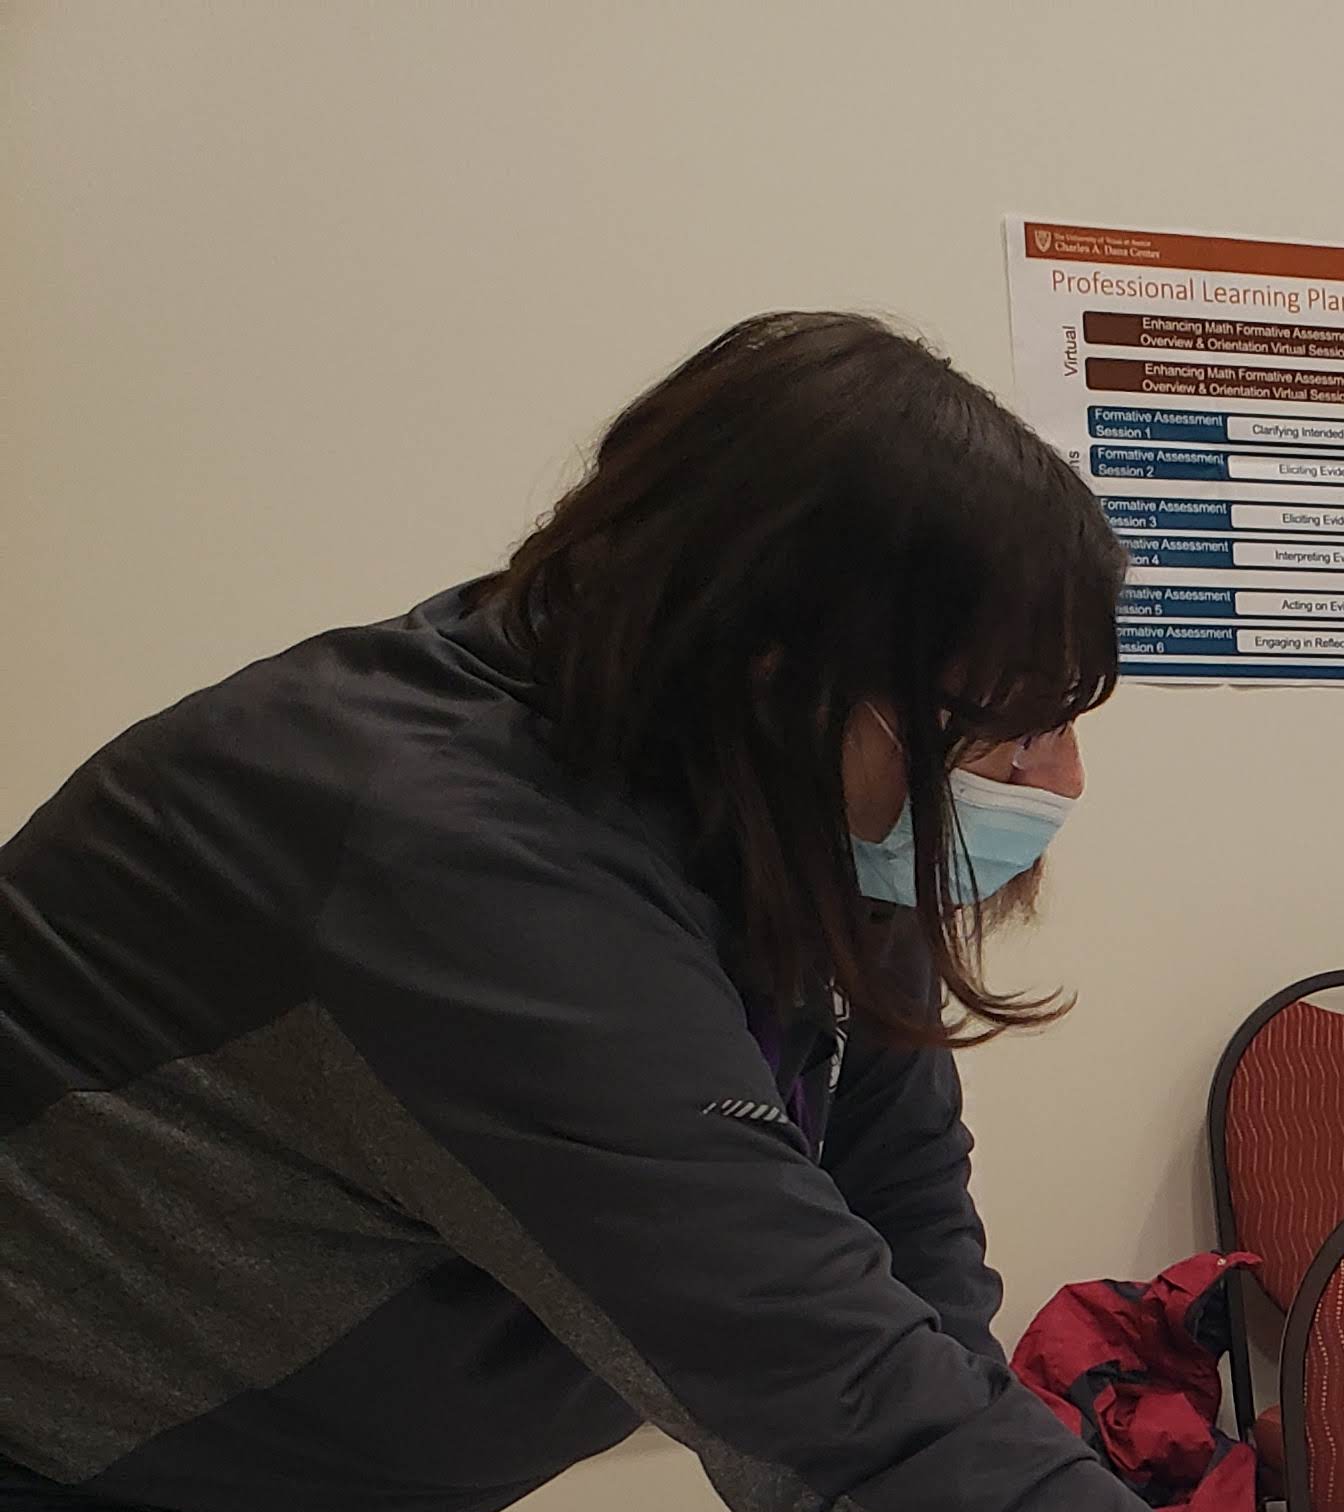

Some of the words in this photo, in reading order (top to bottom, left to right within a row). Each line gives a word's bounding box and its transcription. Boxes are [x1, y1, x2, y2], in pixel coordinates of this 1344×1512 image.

[1052, 270, 1194, 300] Professional
[1202, 281, 1300, 312] Learning
[1143, 318, 1202, 335] Enhancing
[1205, 321, 1233, 335] Math
[1236, 324, 1290, 339] Formative
[1063, 326, 1078, 376] Virtual
[1141, 334, 1193, 349] Overview
[1196, 338, 1205, 350] &
[1208, 338, 1268, 352] Orientation
[1271, 342, 1306, 355] Virtual
[1145, 364, 1205, 379] Enhancing
[1208, 367, 1236, 380] Math
[1238, 369, 1292, 383] Formative
[1143, 380, 1195, 394] Overview
[1199, 383, 1207, 395] &
[1210, 383, 1270, 398] Orientation
[1273, 387, 1308, 400] Virtual
[1095, 409, 1152, 422] Formative
[1154, 411, 1222, 426] Assessment
[1096, 426, 1143, 439] Session
[1146, 428, 1151, 439] 1
[1253, 424, 1300, 439] Clarifying
[1302, 427, 1344, 440] Intended
[1098, 448, 1155, 461] Formative
[1157, 451, 1224, 465] Assessment
[1098, 464, 1144, 477] Session
[1147, 466, 1155, 478] 2
[1279, 464, 1318, 478] Eliciting
[1159, 501, 1227, 515] Assessment
[1149, 517, 1157, 528] 3
[1282, 513, 1321, 526] Eliciting
[1162, 540, 1229, 552] Assessment
[1275, 550, 1331, 565] Interpreting
[1164, 590, 1231, 602] Assessment
[1282, 600, 1313, 612] Acting
[1315, 602, 1327, 611] on
[1166, 628, 1233, 639] Assessment
[1255, 637, 1301, 650] Engaging
[1303, 638, 1312, 647] in
